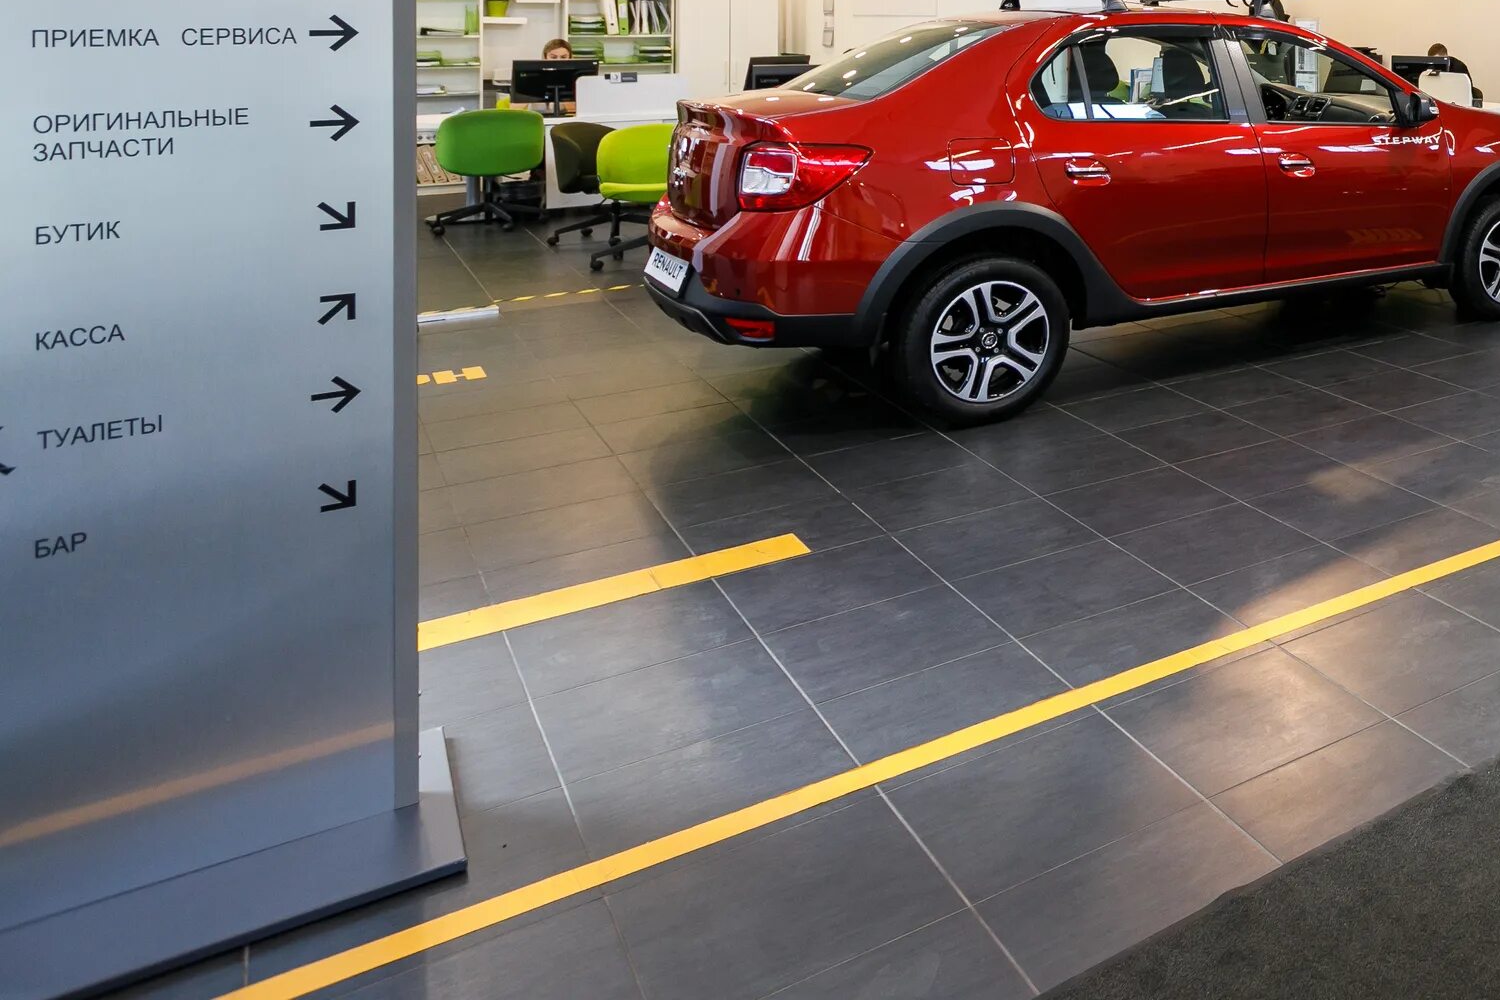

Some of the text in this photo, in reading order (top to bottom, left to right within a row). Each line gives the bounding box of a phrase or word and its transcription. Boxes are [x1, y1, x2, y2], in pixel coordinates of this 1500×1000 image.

[31, 27, 298, 48] ПРИЕМКА СЕРВИСА
[33, 107, 250, 134] ОРИГИНАЛЬНЫЕ
[33, 137, 174, 162] ЗАПЧАСТИ
[1372, 135, 1441, 146] STEPWAY
[34, 220, 121, 245] БУТИК
[652, 252, 684, 280] RENAULT
[34, 323, 126, 351] КАССА
[37, 413, 163, 450] ТУАЛЕТЫ
[34, 531, 87, 559] БАР
